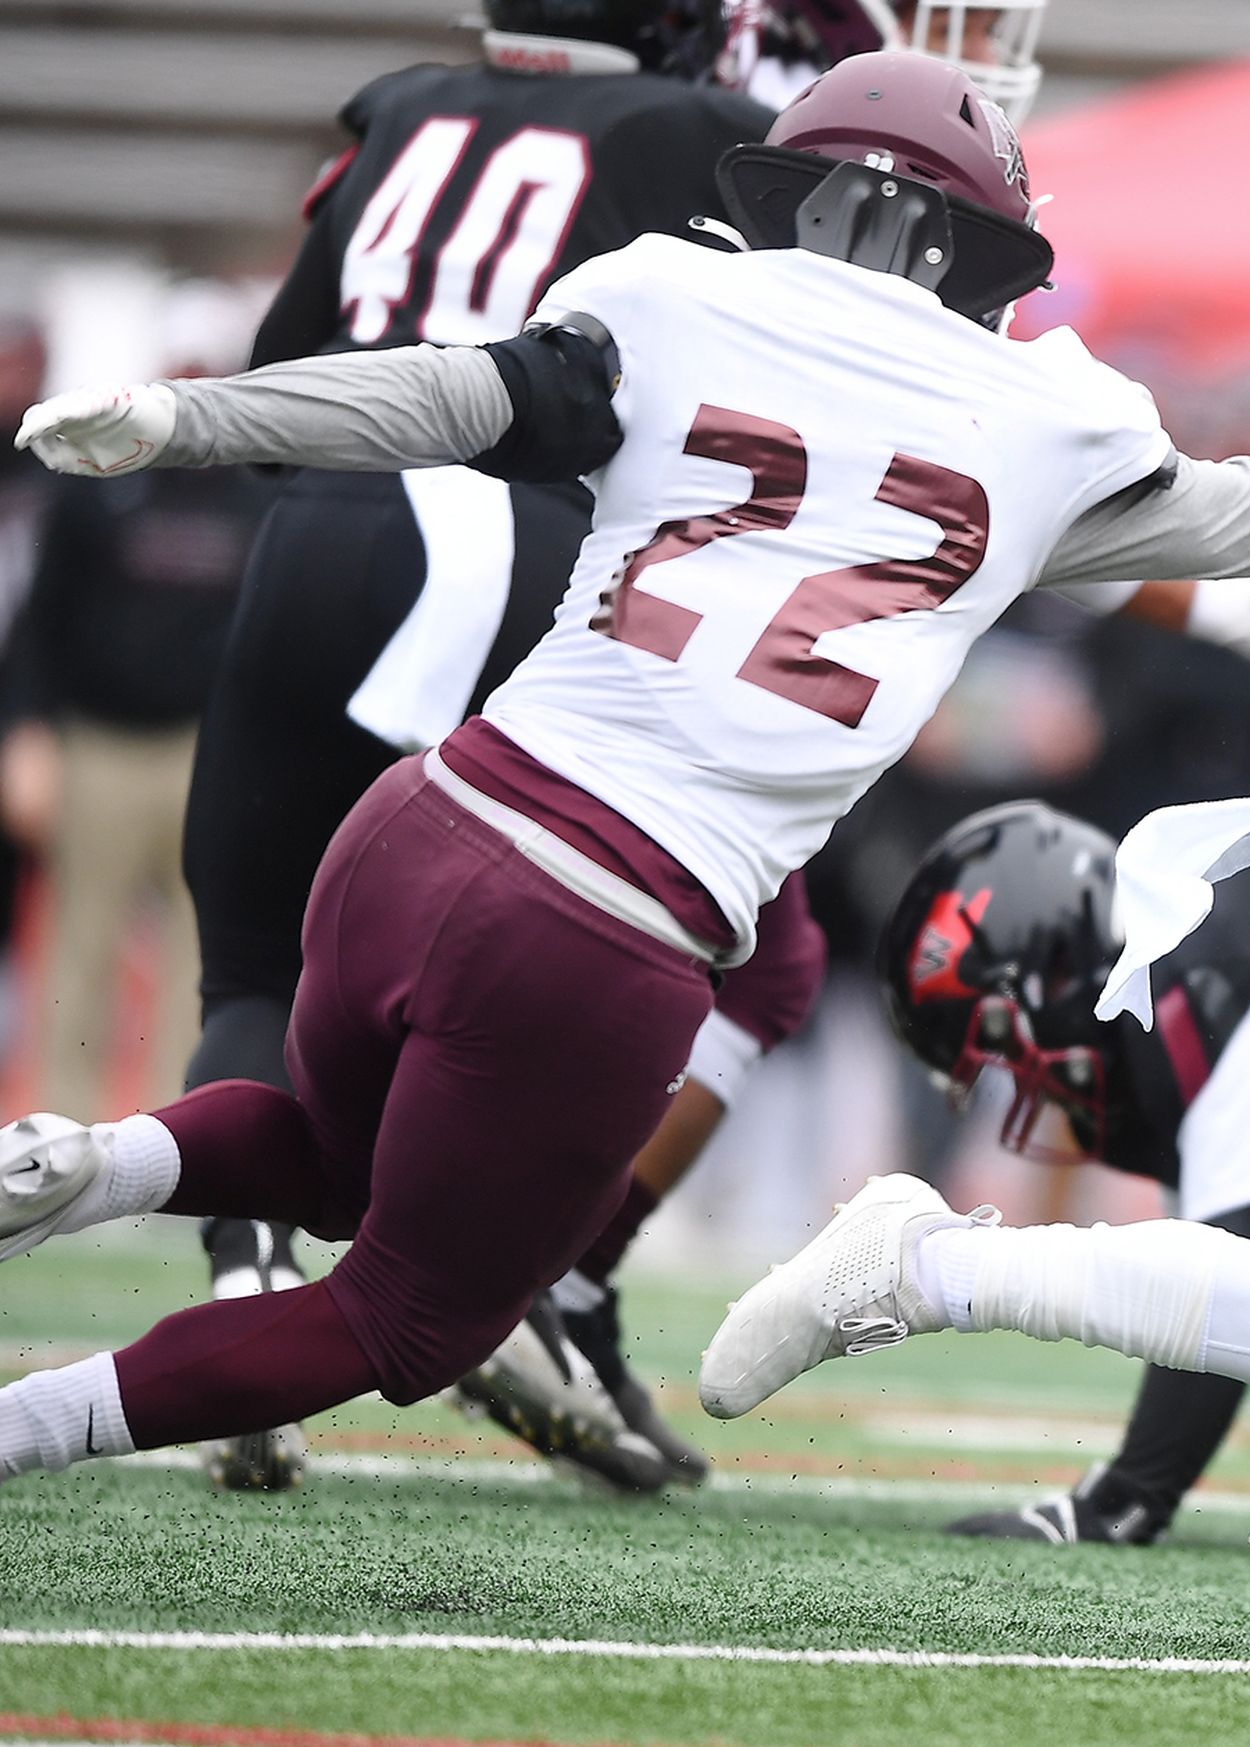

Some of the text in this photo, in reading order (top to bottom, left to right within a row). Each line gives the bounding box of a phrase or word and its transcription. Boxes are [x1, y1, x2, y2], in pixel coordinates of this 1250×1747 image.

[340, 114, 593, 346] 40
[587, 402, 990, 730] 22
[912, 924, 953, 983] W
